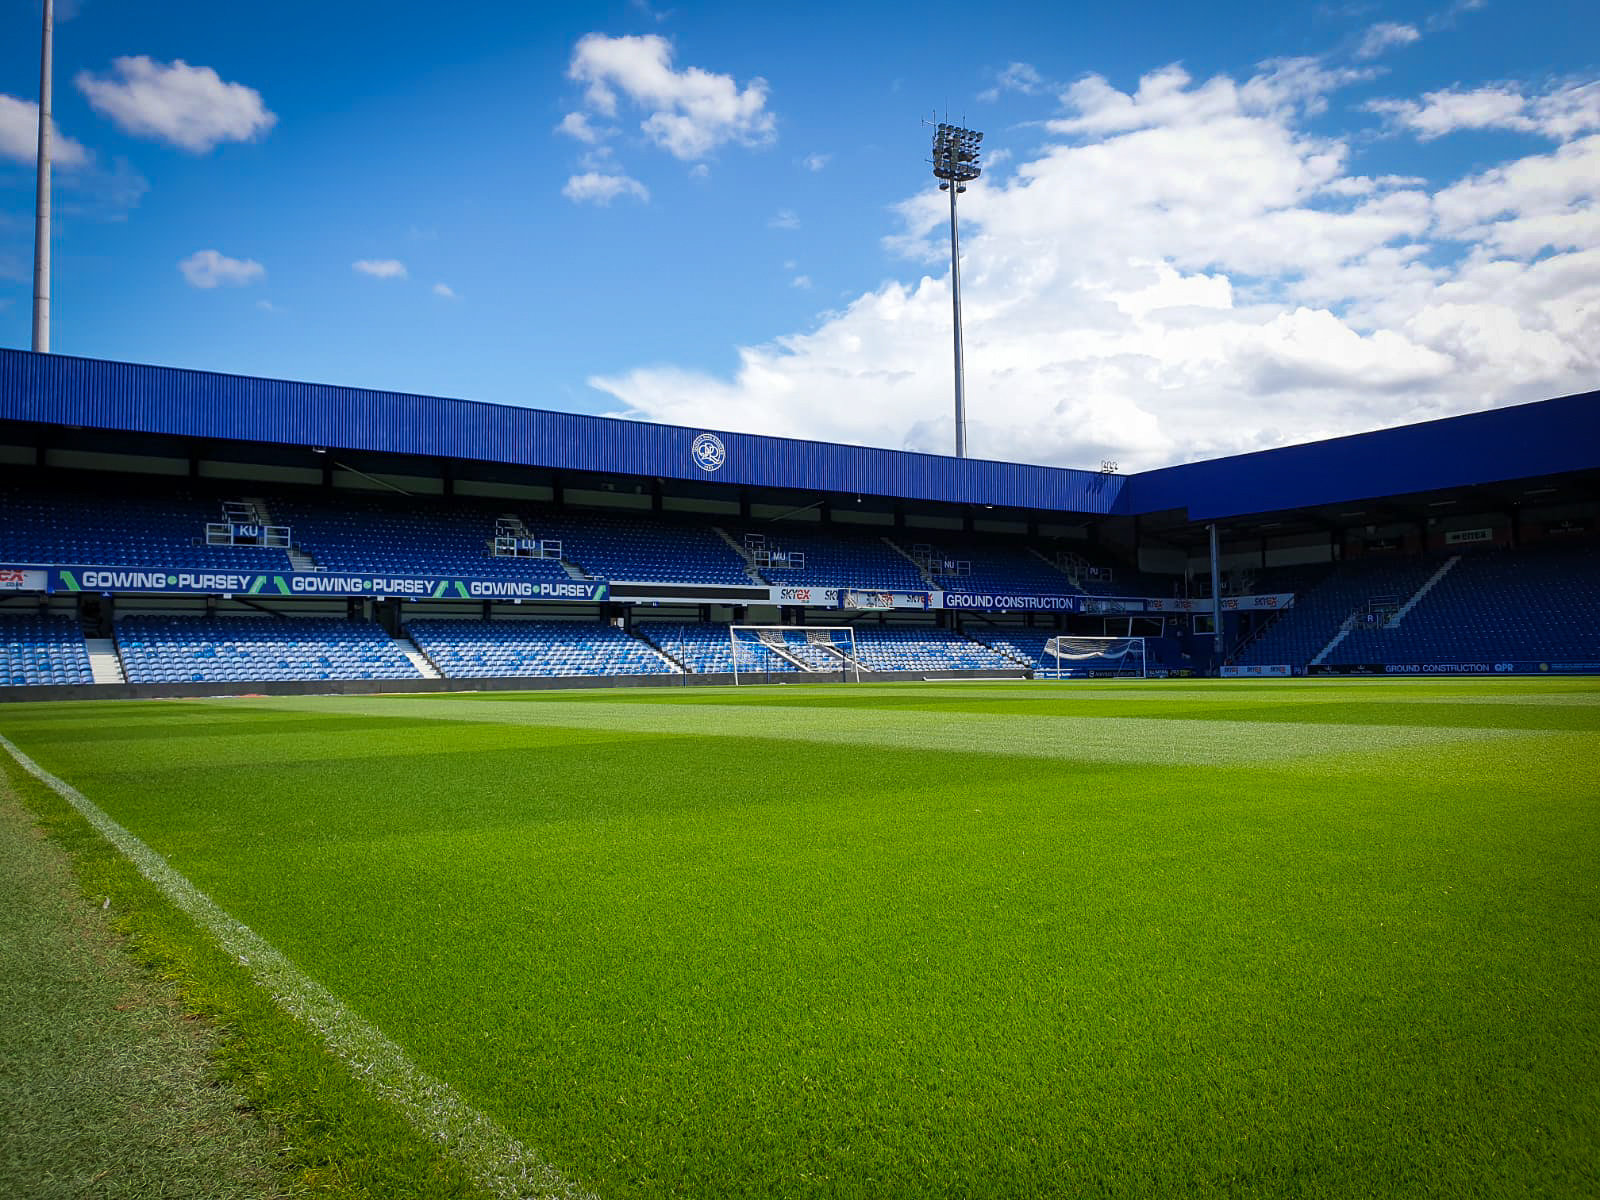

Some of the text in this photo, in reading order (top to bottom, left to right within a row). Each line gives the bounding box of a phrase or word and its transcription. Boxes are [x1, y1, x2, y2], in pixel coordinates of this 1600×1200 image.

[239, 525, 258, 537] KU
[82, 571, 251, 590] GOWING PURSEY
[292, 576, 435, 594] GOWING PURSEY
[470, 581, 594, 597] GOWING PURSEY
[946, 594, 993, 608] GROUND
[994, 595, 1073, 610] CONSTRUCTION
[1385, 663, 1420, 673] GROUND
[1422, 663, 1490, 673] CONSTRUCTION
